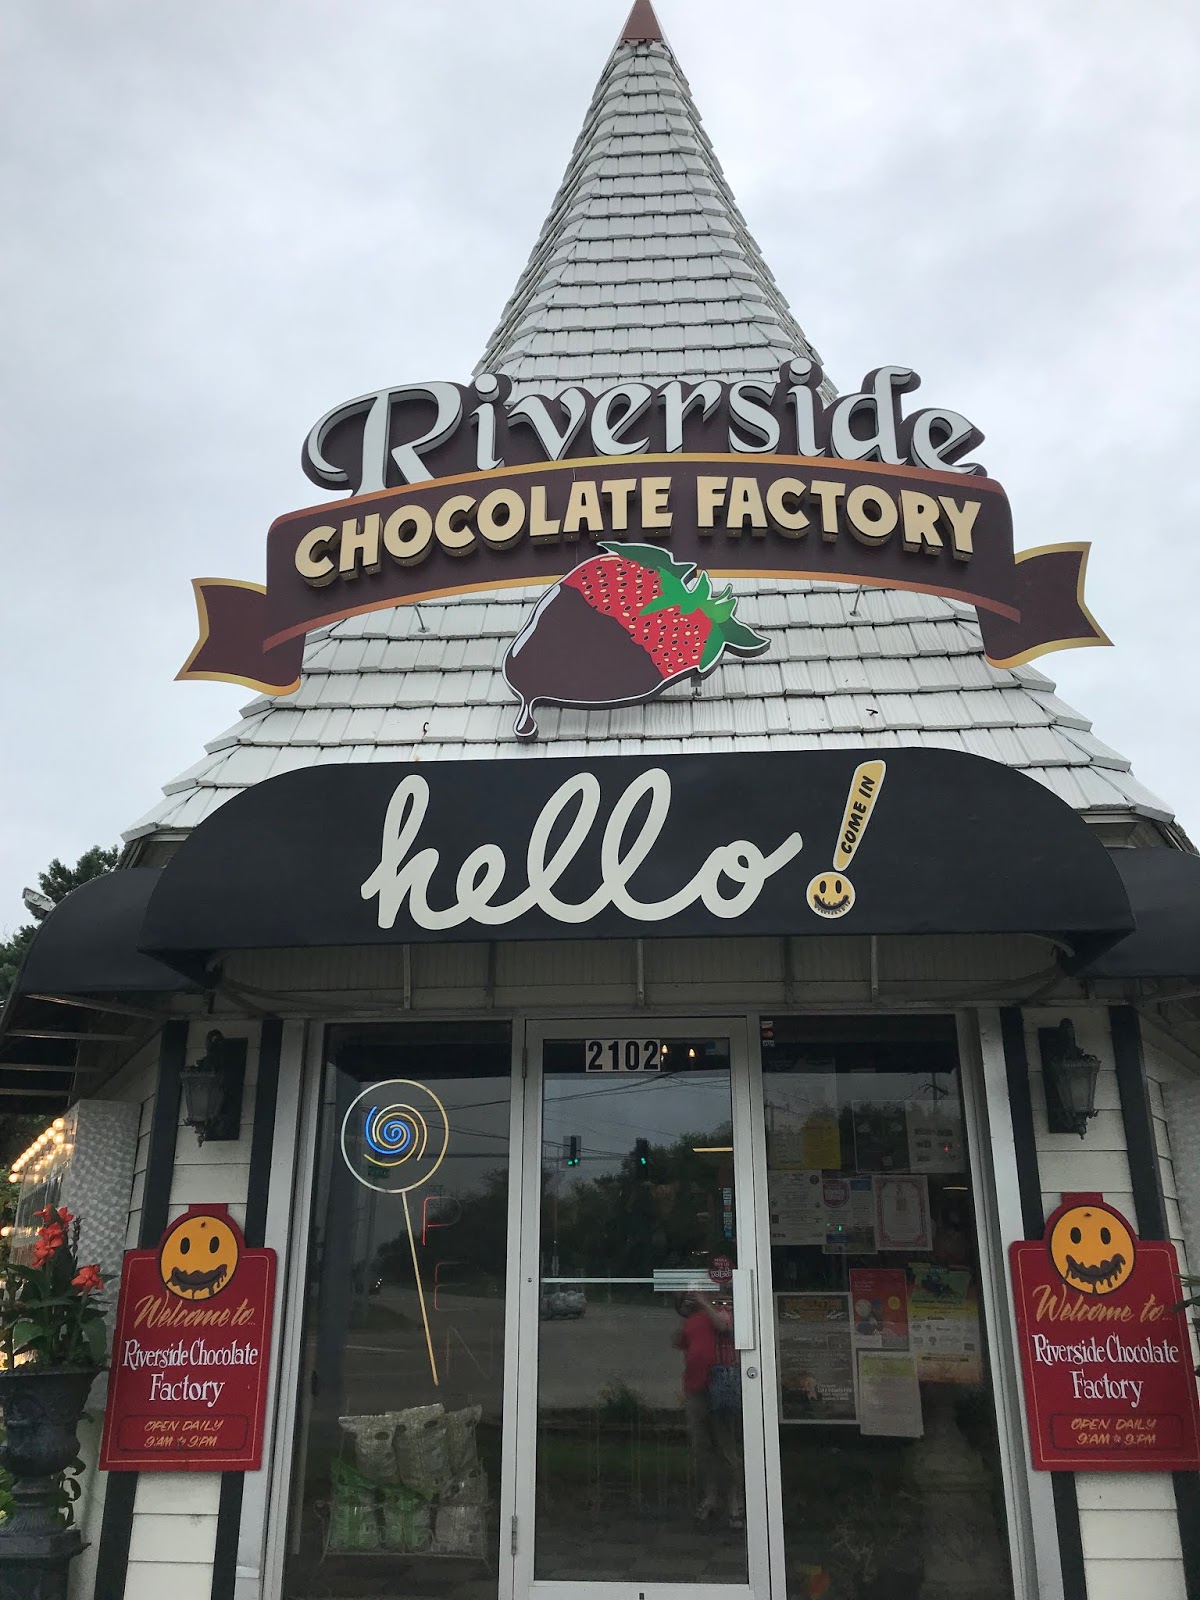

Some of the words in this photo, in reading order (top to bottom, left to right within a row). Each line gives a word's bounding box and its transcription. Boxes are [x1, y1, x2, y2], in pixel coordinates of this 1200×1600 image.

[305, 358, 984, 498] Riverside
[294, 476, 673, 586] CHOCOLATE
[696, 476, 982, 562] FACTORY
[841, 801, 867, 854] COME
[858, 775, 876, 799] IN
[587, 1040, 660, 1071] 2102
[134, 1290, 230, 1328] Welcome
[1032, 1284, 1134, 1324] Welcome
[122, 1339, 189, 1370] Riverside
[189, 1337, 258, 1367] Chocolate
[1032, 1333, 1105, 1365] Riverside
[1106, 1331, 1180, 1364] Chocolate
[149, 1371, 226, 1408] Factory
[1069, 1368, 1144, 1408] Factory
[144, 1420, 180, 1432] OPEN
[181, 1419, 224, 1432] DAILY
[1071, 1418, 1111, 1430] OPEN
[1115, 1418, 1157, 1430] DAILY
